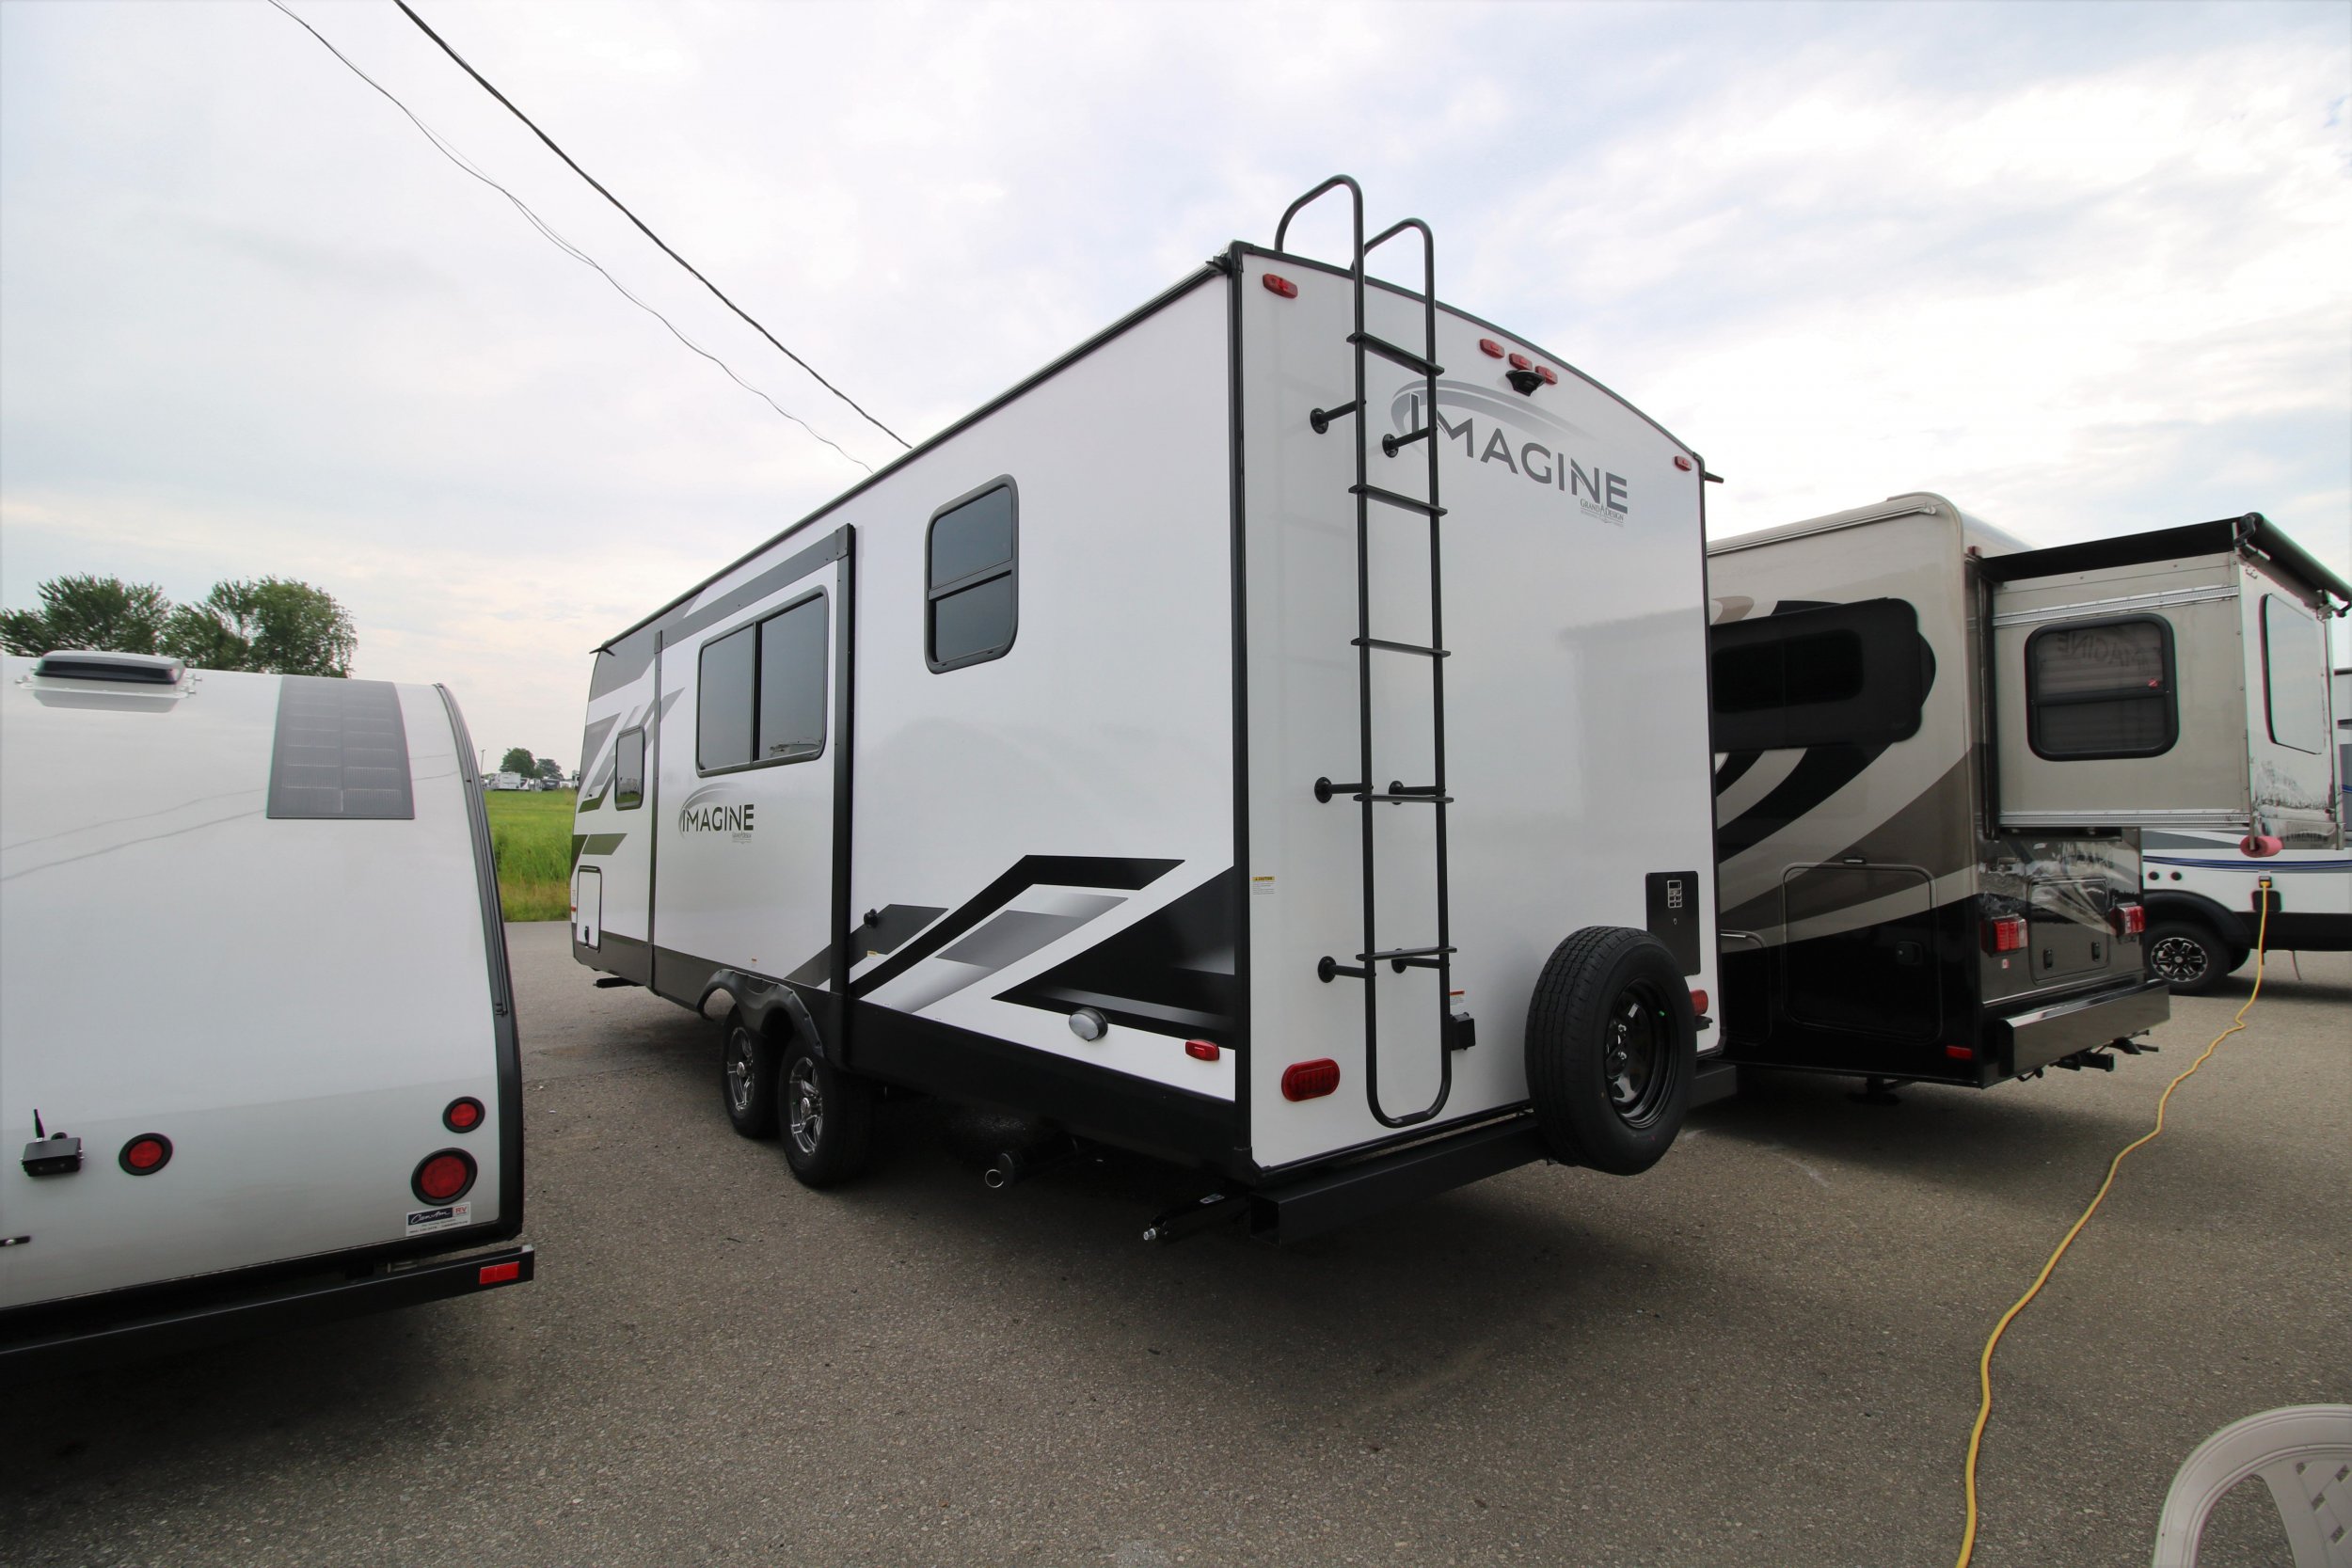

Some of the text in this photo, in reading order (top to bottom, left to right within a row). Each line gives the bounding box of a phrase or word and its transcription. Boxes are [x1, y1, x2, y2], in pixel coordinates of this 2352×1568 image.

[1409, 391, 1629, 515] IMAGINE
[682, 804, 755, 832] IMAGINE
[455, 1206, 468, 1214] RV
